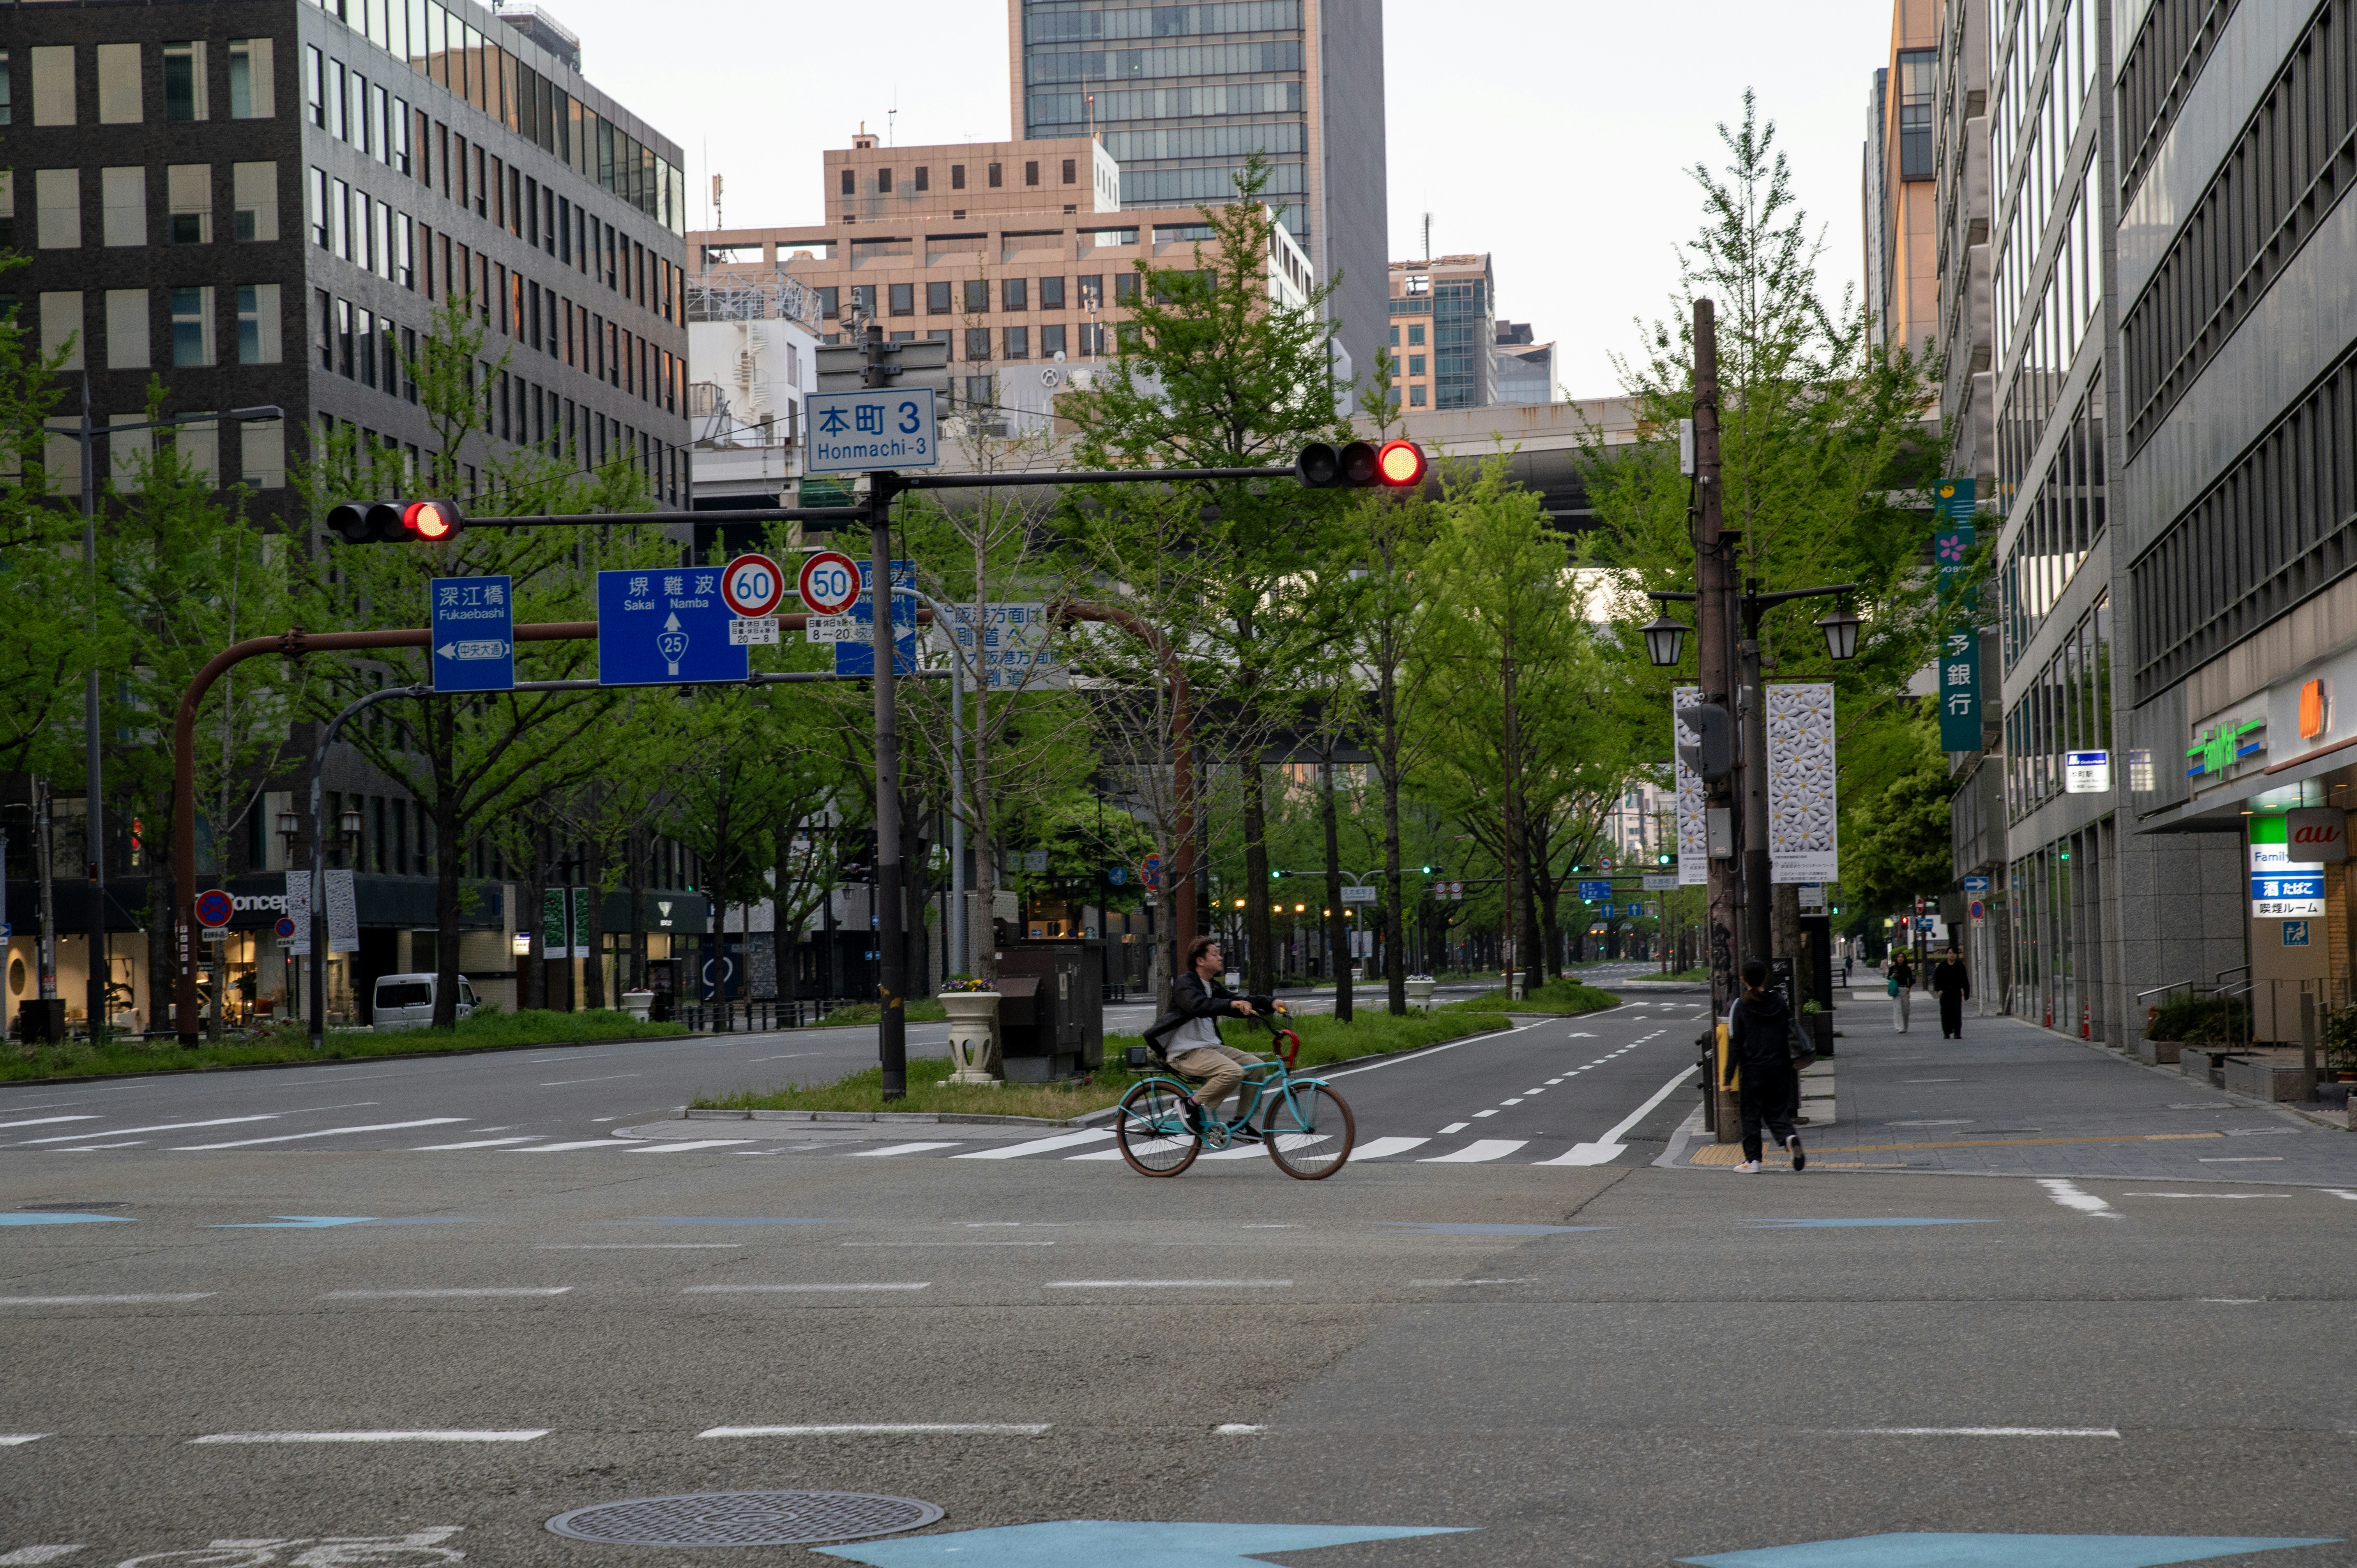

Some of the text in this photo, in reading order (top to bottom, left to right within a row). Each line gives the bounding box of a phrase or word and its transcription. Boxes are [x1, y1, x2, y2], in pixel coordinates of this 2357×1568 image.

[819, 401, 920, 437] 本町 3
[818, 437, 926, 459] Honmachi-3
[629, 577, 649, 597] 堺
[737, 572, 769, 599] 60
[814, 570, 846, 597] 50
[440, 585, 504, 606] 深江橋
[624, 597, 709, 611] Sakai Namba
[440, 607, 504, 620] Fukaebashi
[738, 635, 748, 643] 20
[813, 630, 820, 640] 8
[836, 629, 850, 639] 20
[460, 643, 501, 657] 中央大通
[664, 637, 682, 653] 25
[2295, 826, 2341, 844] au
[2263, 881, 2314, 897] 酒 たばこ
[2260, 902, 2318, 914] 喫煙ルーム
